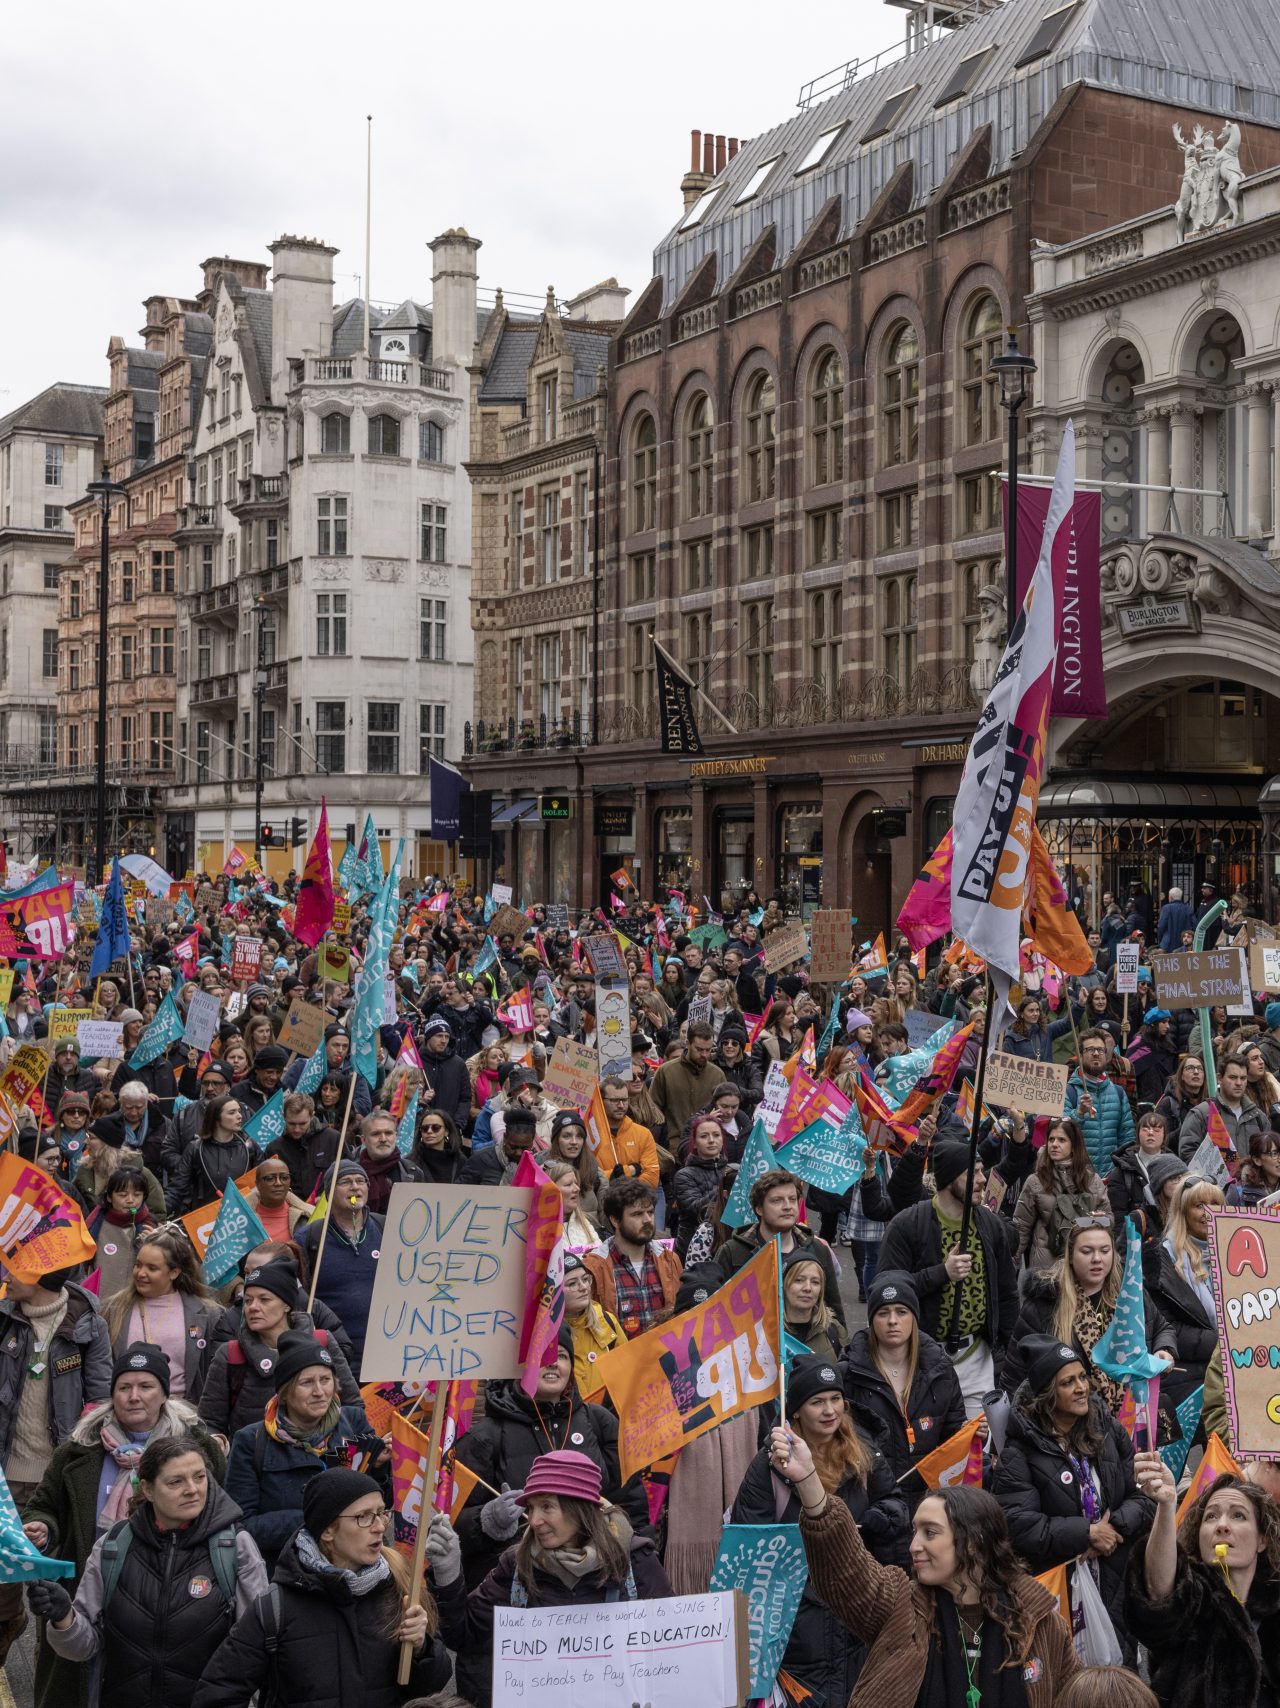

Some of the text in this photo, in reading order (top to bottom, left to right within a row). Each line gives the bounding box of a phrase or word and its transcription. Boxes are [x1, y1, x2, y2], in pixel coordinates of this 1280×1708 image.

[1126, 605, 1180, 623] BURLINGTON
[1145, 617, 1167, 626] ARCADE
[676, 686, 696, 741] SKINNER
[869, 752, 886, 762] HOUSE
[691, 758, 767, 776] BENTLEY SKINNER
[962, 816, 1002, 901] PAY
[235, 942, 261, 954] STRIKE
[235, 952, 260, 966] TO WIN
[1119, 954, 1137, 964] TORIES
[1119, 962, 1137, 973] OUT!
[1153, 953, 1230, 973] THIS IS THE
[1156, 978, 1242, 999] FINAL STRAW
[55, 1012, 91, 1024] SUPPORT
[81, 1049, 120, 1057] IMPORTANT
[552, 1062, 582, 1078] SCHOOL
[574, 1060, 589, 1070] ARE
[989, 1053, 1062, 1080] TEACHER:
[543, 1080, 570, 1098] SCHOOL
[571, 1079, 589, 1092] NOT
[1002, 1069, 1064, 1093] ENDANGERED
[987, 1077, 1063, 1105] SPECIES!!
[792, 1142, 861, 1172] education
[806, 1159, 835, 1175] union
[399, 1196, 529, 1247] OVER
[1226, 1225, 1269, 1279] A
[396, 1246, 501, 1287] USED
[427, 1283, 461, 1305] &
[383, 1300, 520, 1339] UNDER
[190, 1584, 203, 1595] UP
[499, 1597, 721, 1628] Want to TEACH the world to SING ?
[501, 1617, 731, 1656] FUND MUSIC EDUCATION!
[503, 1662, 681, 1697] Pay schools to Pay Teachers
